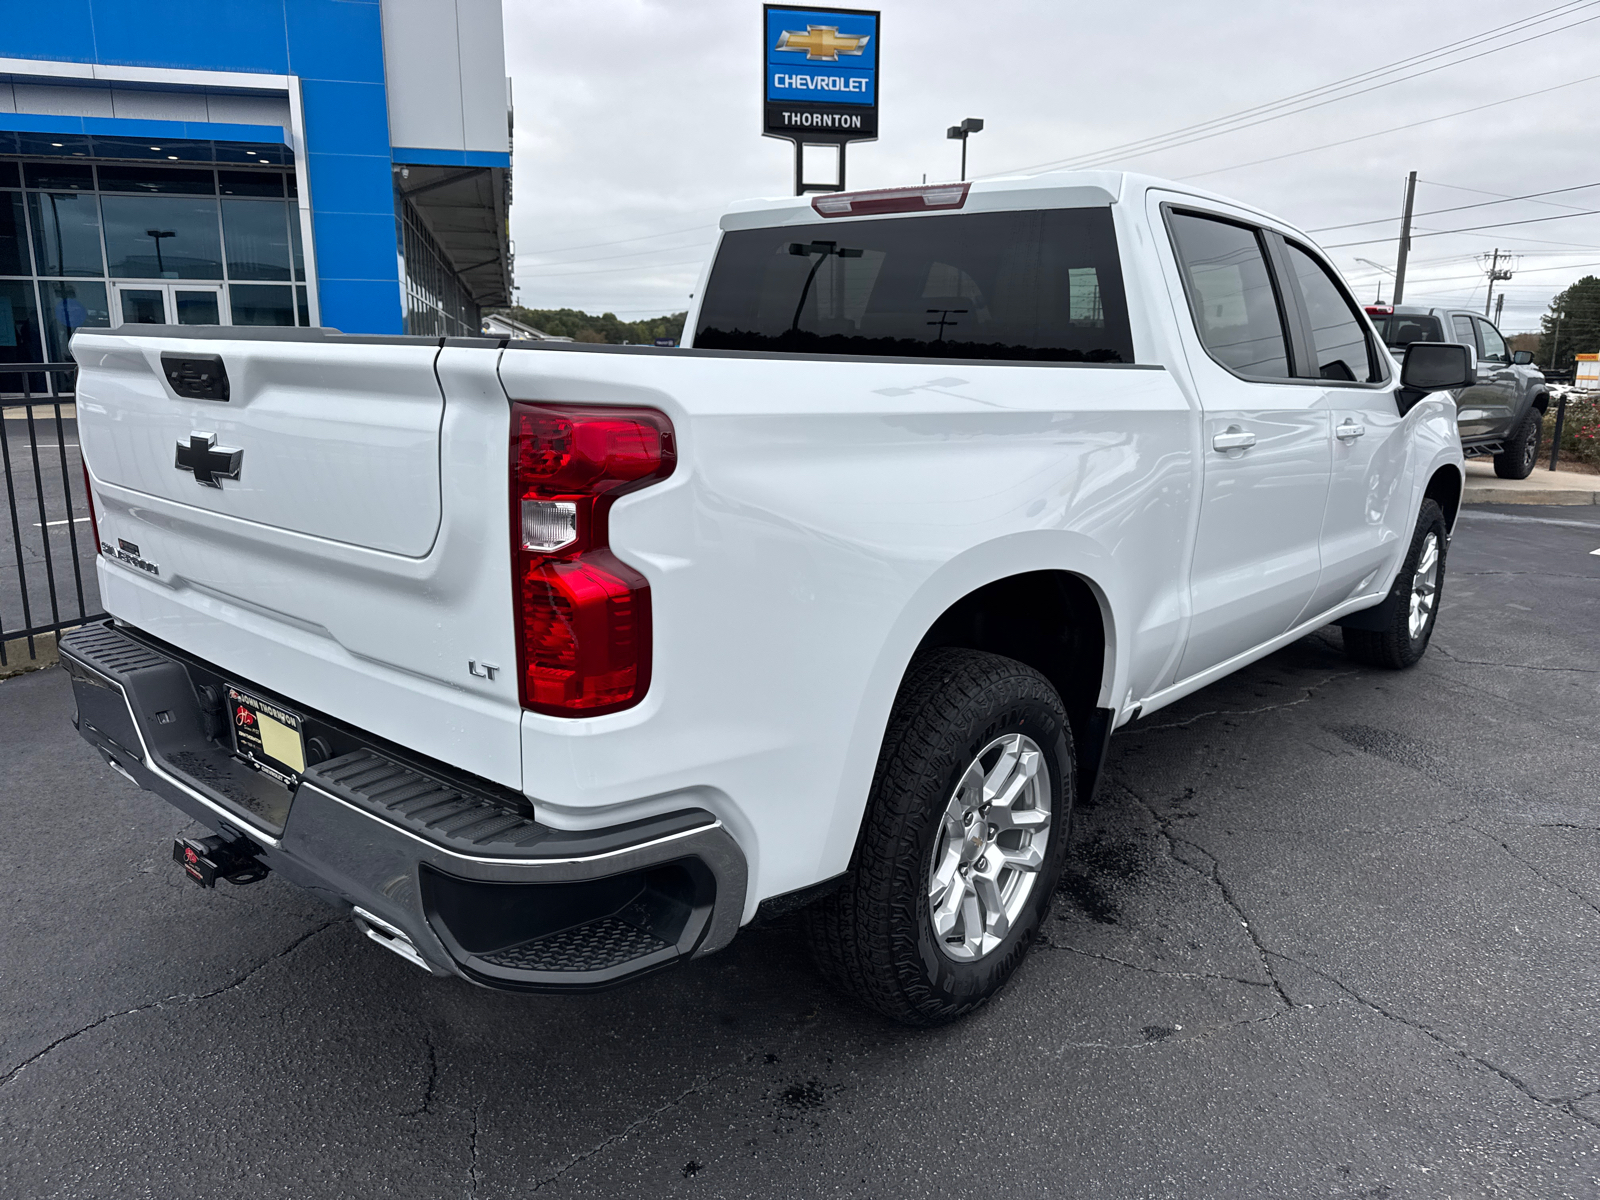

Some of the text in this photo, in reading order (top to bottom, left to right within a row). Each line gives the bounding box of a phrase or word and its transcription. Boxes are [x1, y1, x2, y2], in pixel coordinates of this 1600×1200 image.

[774, 73, 869, 92] CHEVROLET
[782, 112, 861, 128] THORNTON
[468, 660, 500, 681] LT
[240, 694, 260, 710] JOHN
[259, 702, 297, 728] THORNTON
[968, 706, 1055, 758] WRANGLER
[1060, 773, 1070, 844] TERRITORY
